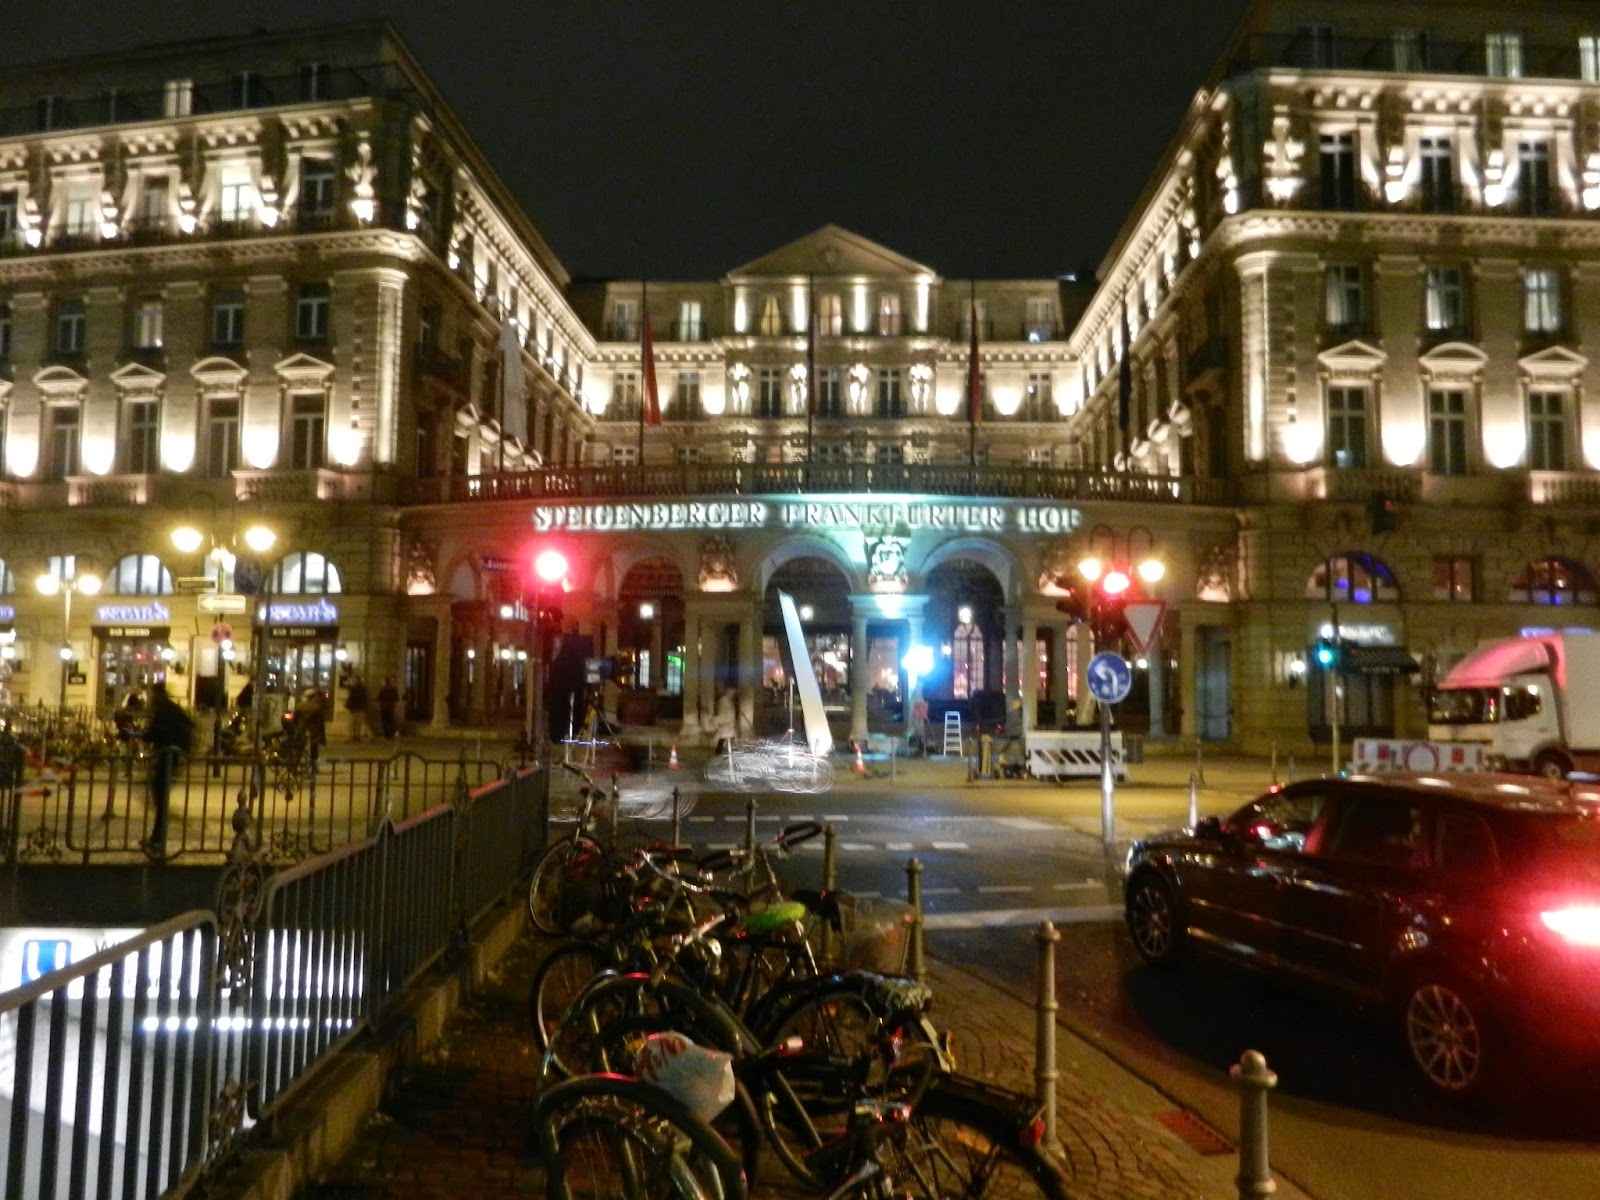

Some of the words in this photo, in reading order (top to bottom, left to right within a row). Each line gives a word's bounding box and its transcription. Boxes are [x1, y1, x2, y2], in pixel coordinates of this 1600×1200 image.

[534, 502, 767, 531] STEIGENBERGER
[782, 502, 1004, 531] FRANKFURTER
[1018, 506, 1082, 533] HOF
